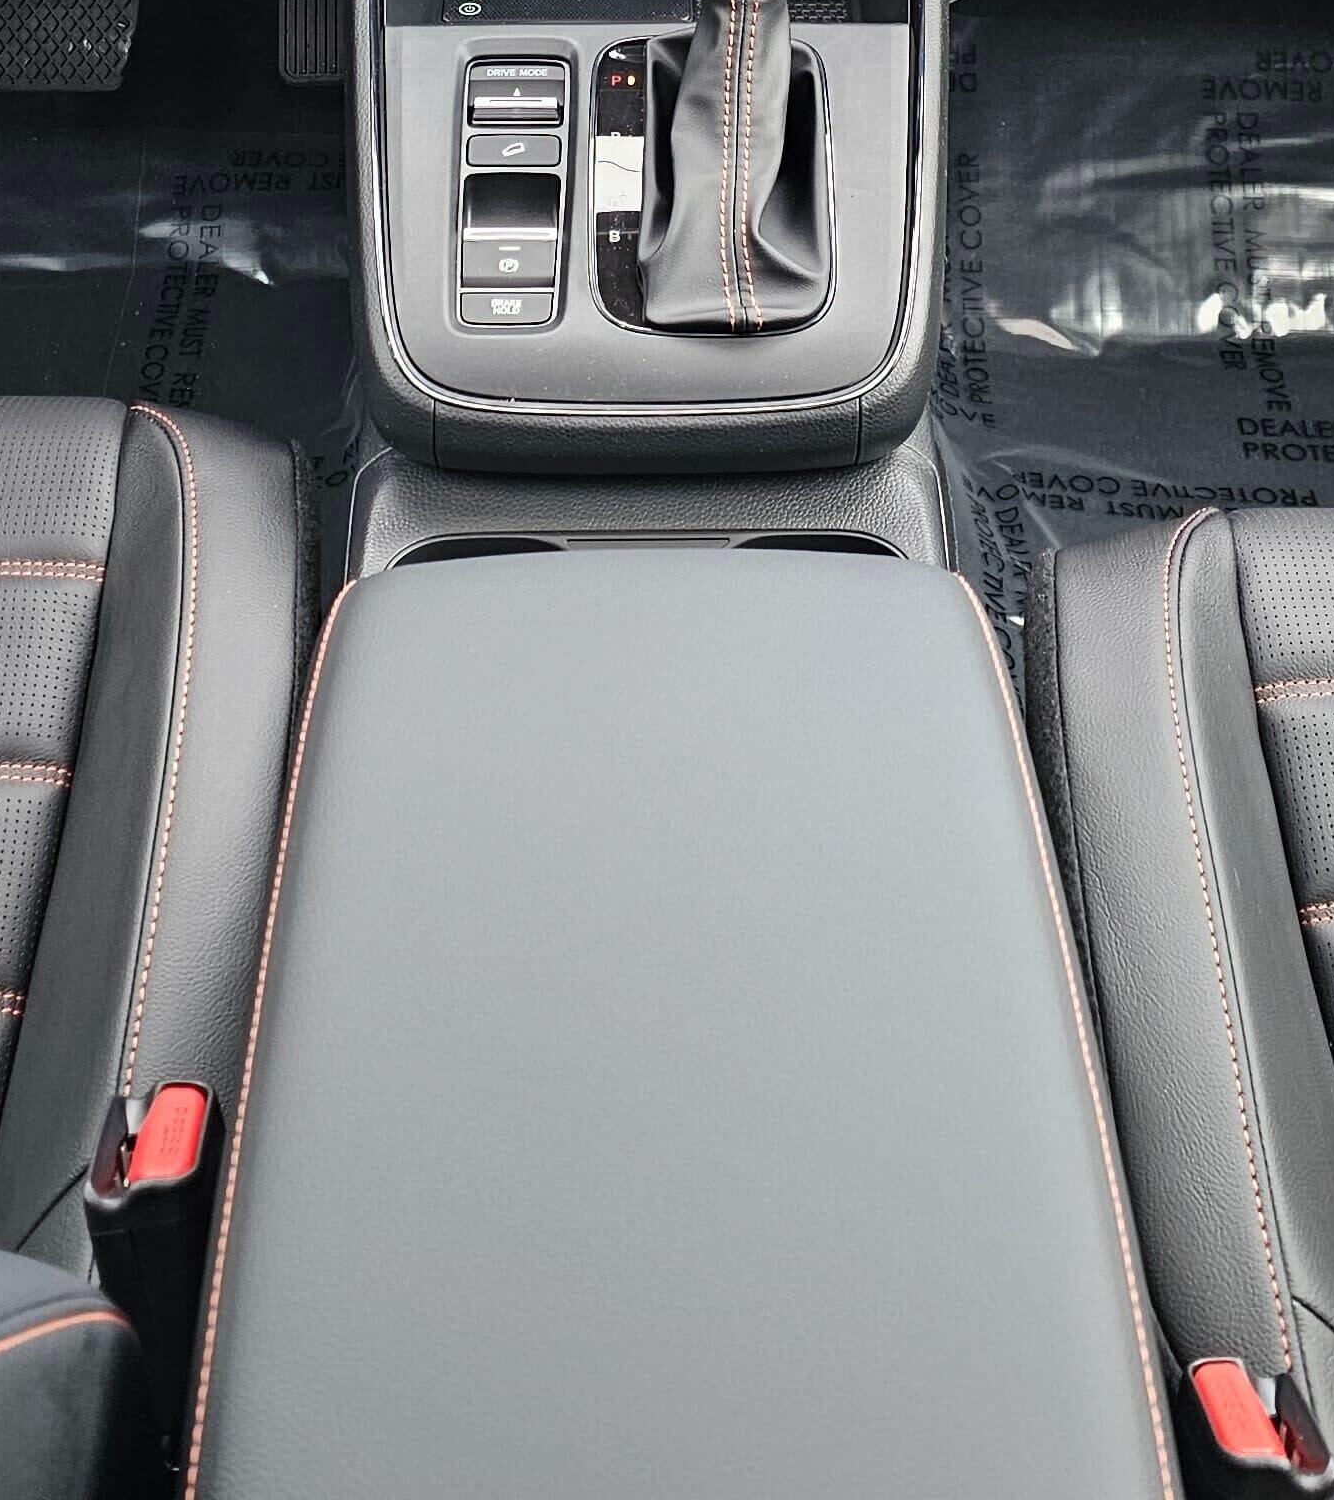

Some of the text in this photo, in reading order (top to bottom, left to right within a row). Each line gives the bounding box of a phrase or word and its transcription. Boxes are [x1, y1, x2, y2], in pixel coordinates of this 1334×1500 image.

[487, 68, 547, 77] DRIVE MODE
[1202, 76, 1323, 102] REMOVE
[171, 172, 291, 196] REMOVE
[957, 150, 985, 250] COVER
[191, 202, 224, 300] DEALER
[608, 229, 620, 243] B
[149, 204, 193, 341] PROTECTIVE
[492, 306, 521, 315] HOLD
[960, 259, 993, 405] PROTECTIVE
[1014, 471, 1320, 508] PROTECTIVE COVER
